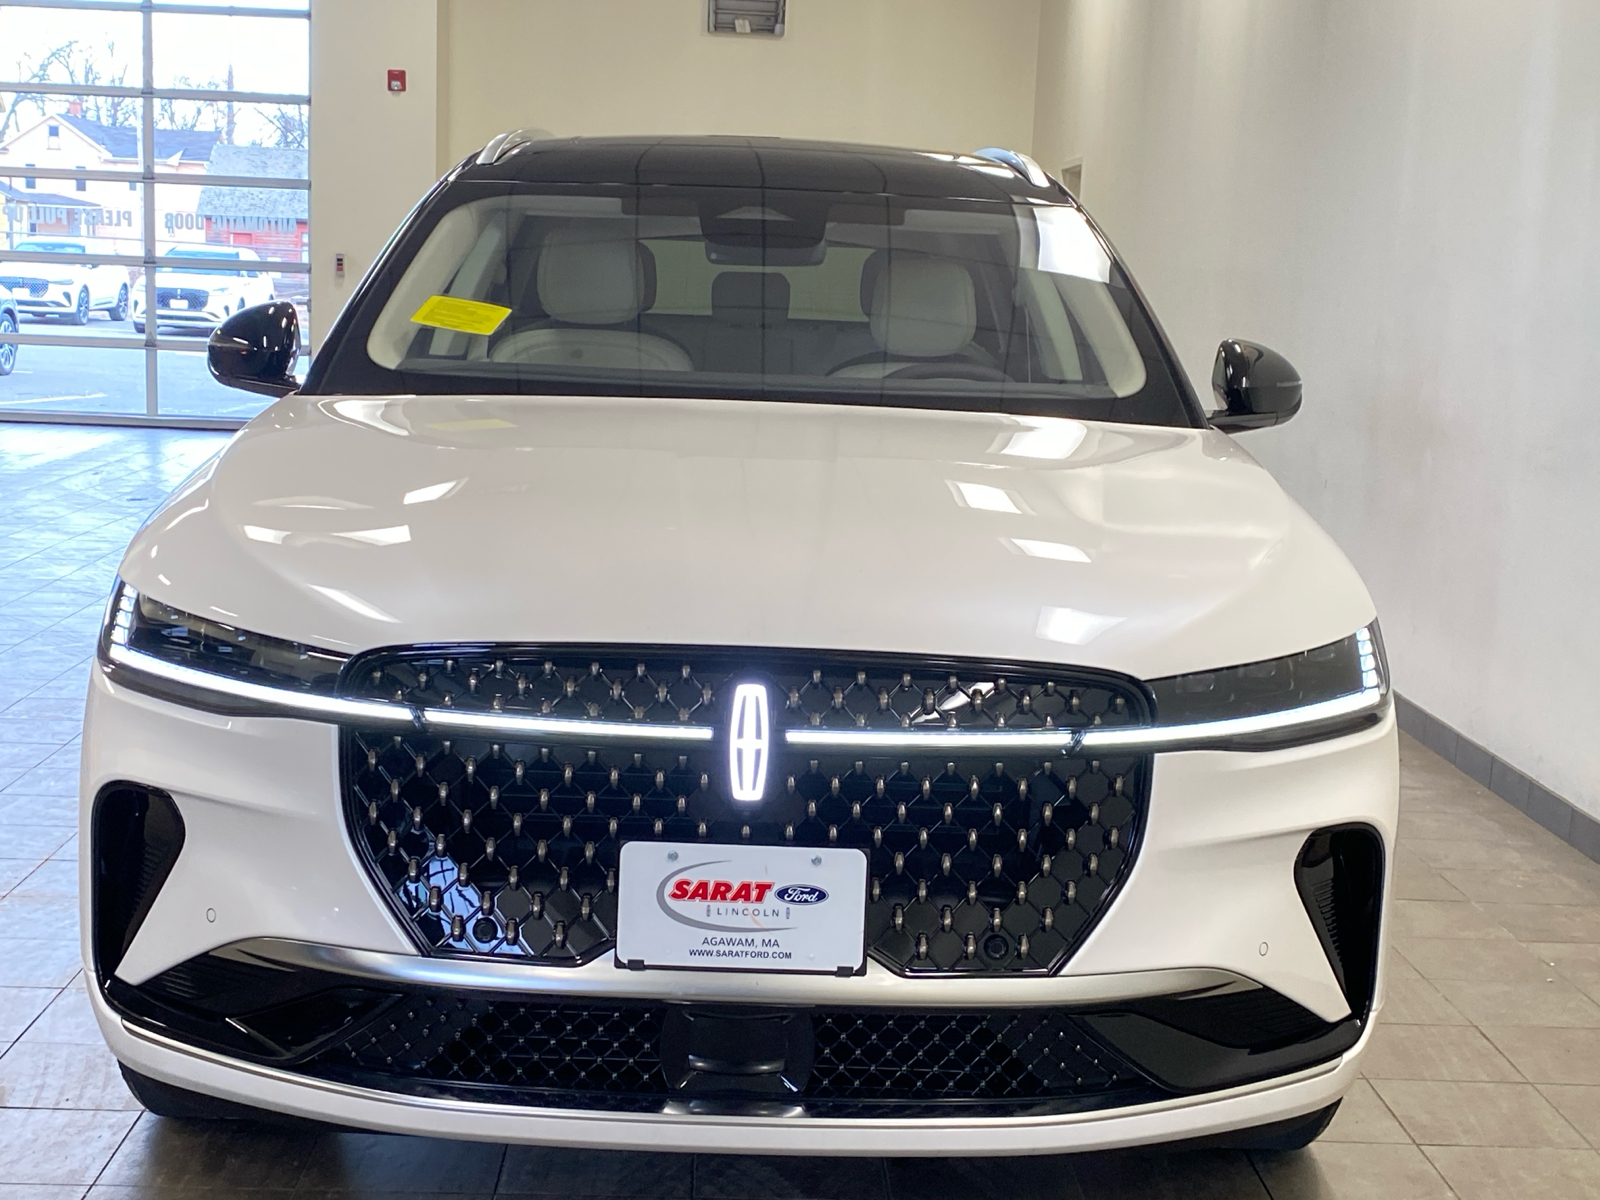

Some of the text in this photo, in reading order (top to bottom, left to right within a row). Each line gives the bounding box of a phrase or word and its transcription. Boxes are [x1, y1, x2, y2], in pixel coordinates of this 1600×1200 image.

[668, 878, 819, 904] SARAT Ford
[716, 907, 780, 917] LINCOLN
[701, 936, 780, 949] AGAWAM, MA
[688, 949, 792, 960] WWW.SARATFORD.COM
